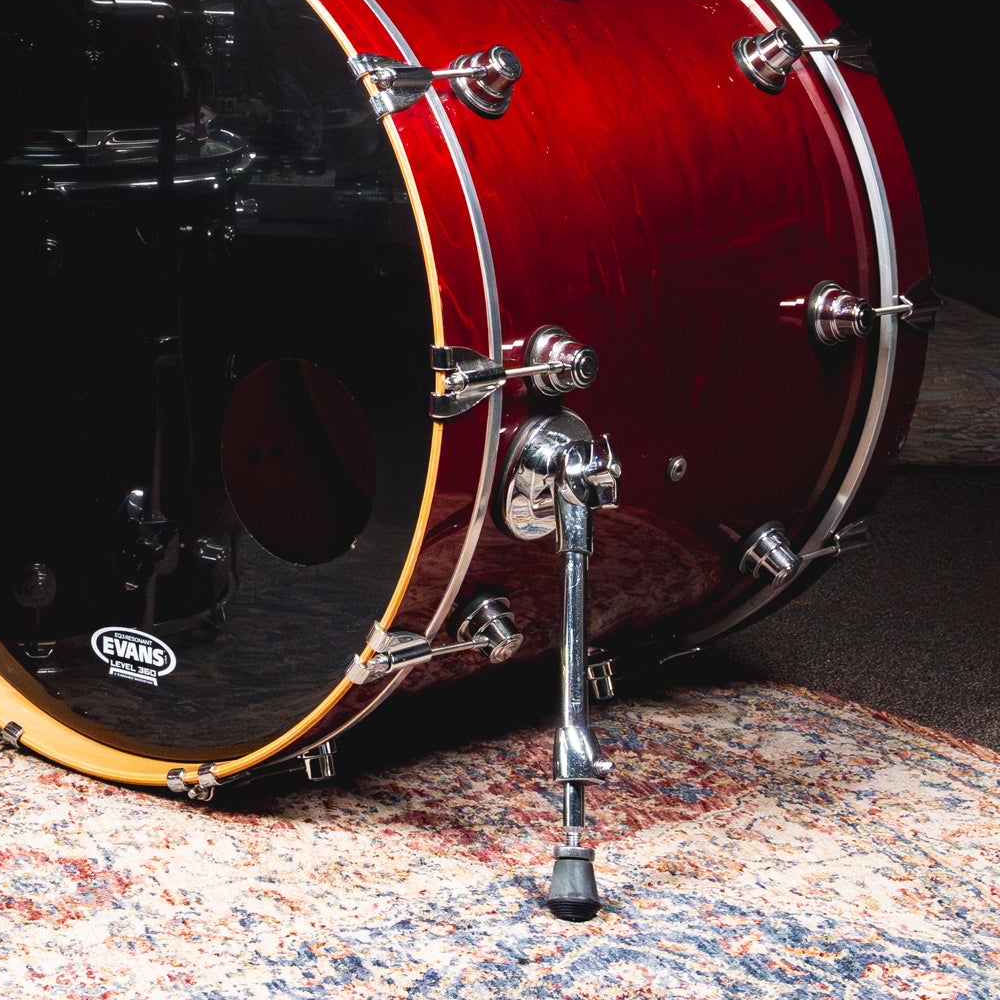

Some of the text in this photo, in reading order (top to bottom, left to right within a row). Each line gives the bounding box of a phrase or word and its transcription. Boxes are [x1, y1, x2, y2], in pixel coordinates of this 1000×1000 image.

[103, 636, 164, 667] EVANS
[110, 660, 157, 677] LEVEL 360
